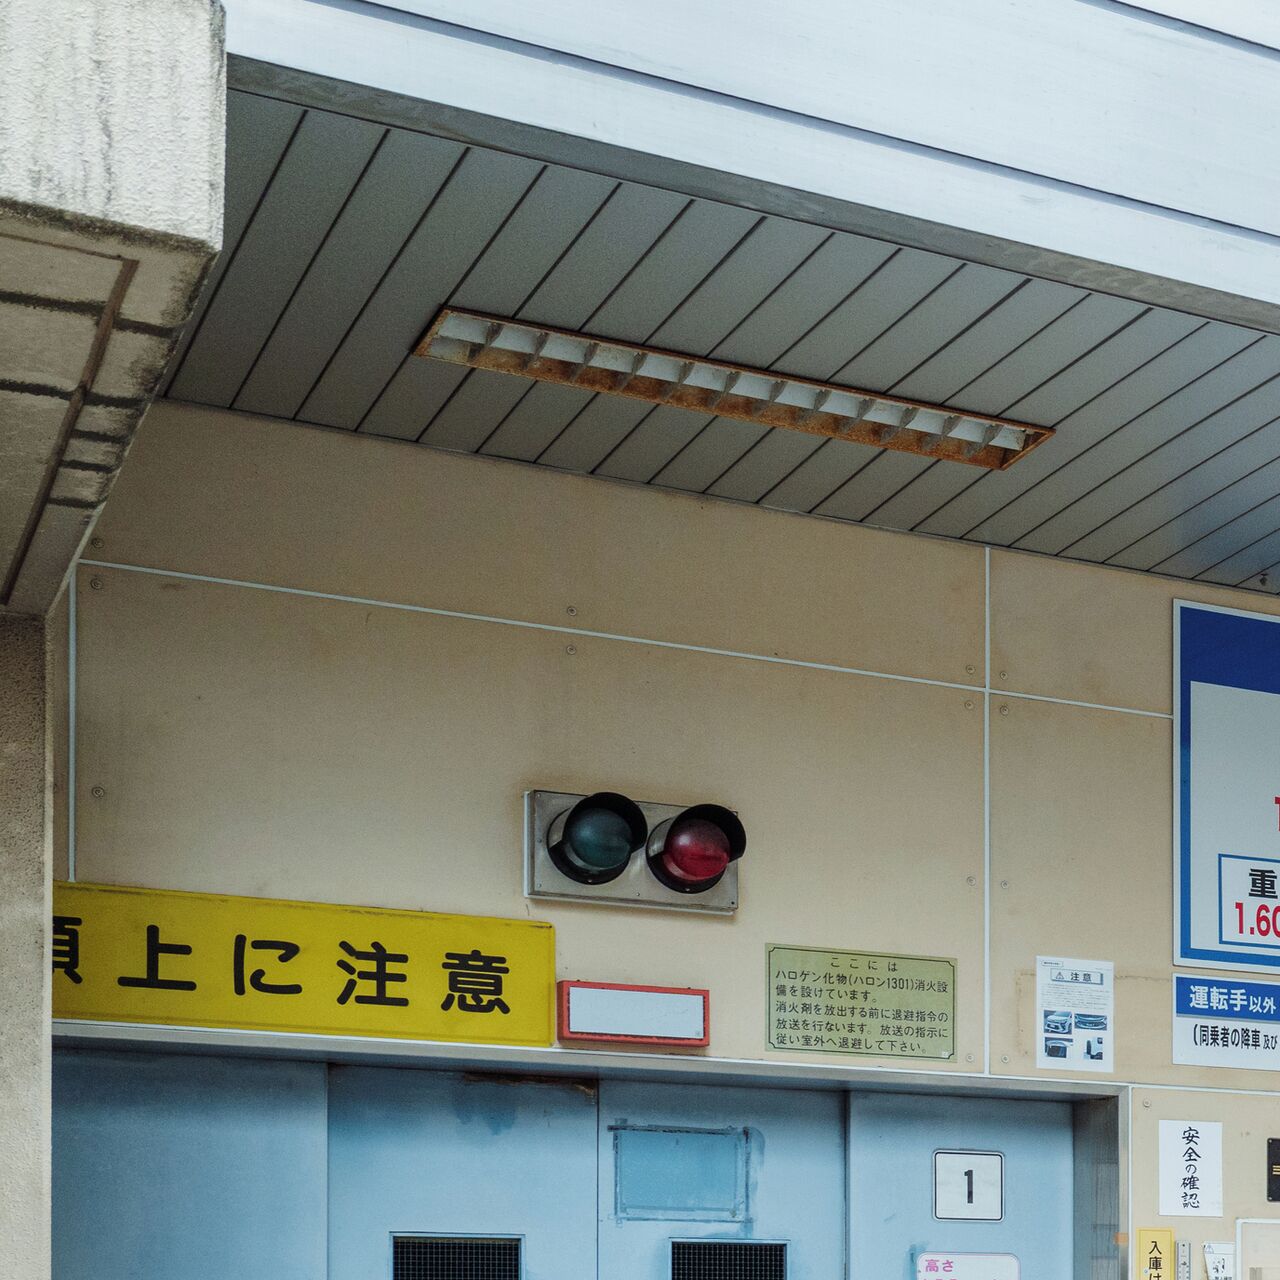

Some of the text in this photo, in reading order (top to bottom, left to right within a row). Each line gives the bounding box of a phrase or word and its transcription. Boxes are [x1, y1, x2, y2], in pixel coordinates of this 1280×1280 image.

[831, 957, 898, 973] ここには
[775, 970, 949, 994] ハロゲン化物(ハロン1301)消火設
[775, 984, 878, 1004] 備を設けています。
[775, 1000, 949, 1023] 消火剤を放出する前に退避指令の
[775, 1017, 949, 1039] 放送を行ないます。放送の指示に
[775, 1034, 927, 1054] 従い室外へ退避して下さい。
[1180, 1126, 1201, 1209] 安全の確認
[964, 1170, 974, 1204] 1
[925, 1259, 954, 1273] 高さ
